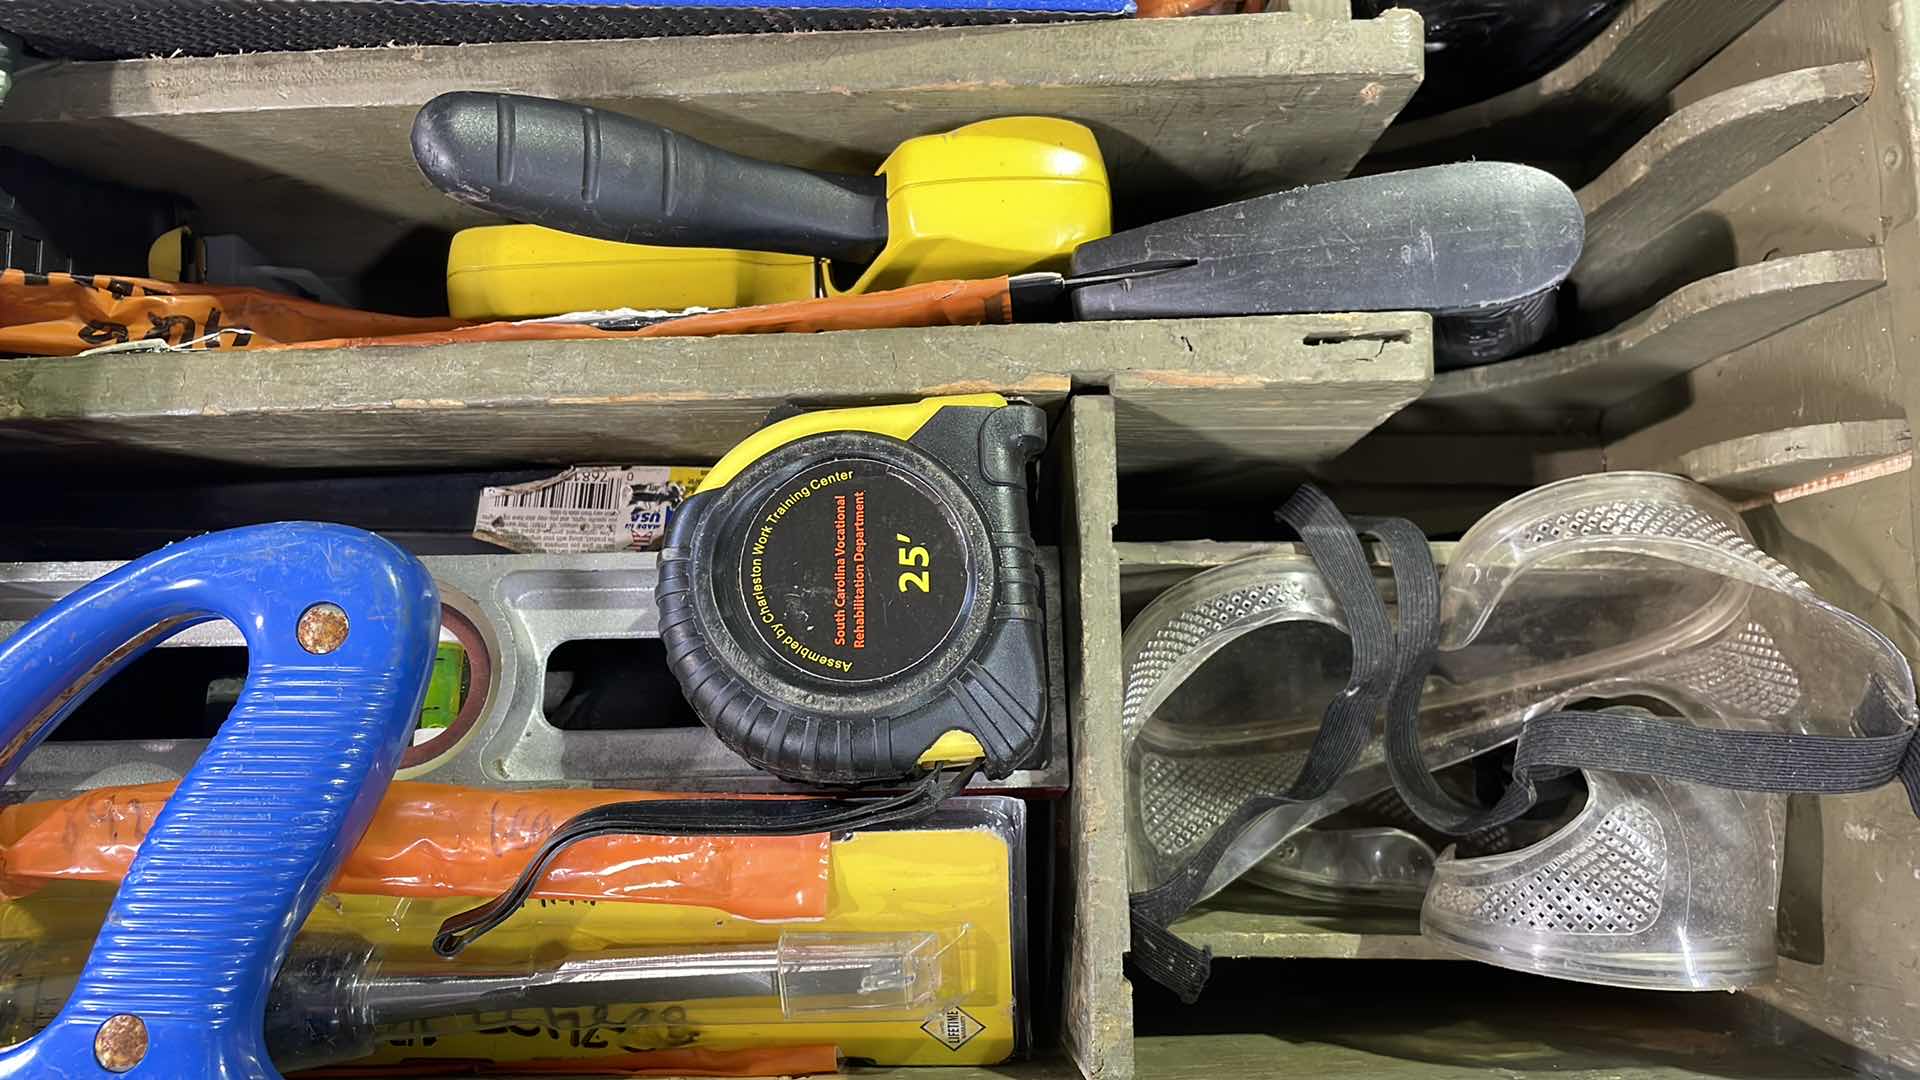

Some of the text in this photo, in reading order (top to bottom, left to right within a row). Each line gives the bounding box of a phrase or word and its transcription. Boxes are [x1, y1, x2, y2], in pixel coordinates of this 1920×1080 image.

[751, 469, 854, 672] Assembled by Charleston Work Training Center
[834, 495, 847, 646] South Carolina Vocational
[853, 491, 867, 649] Rehabilitation Department
[947, 1011, 960, 1043] LIFETIME
